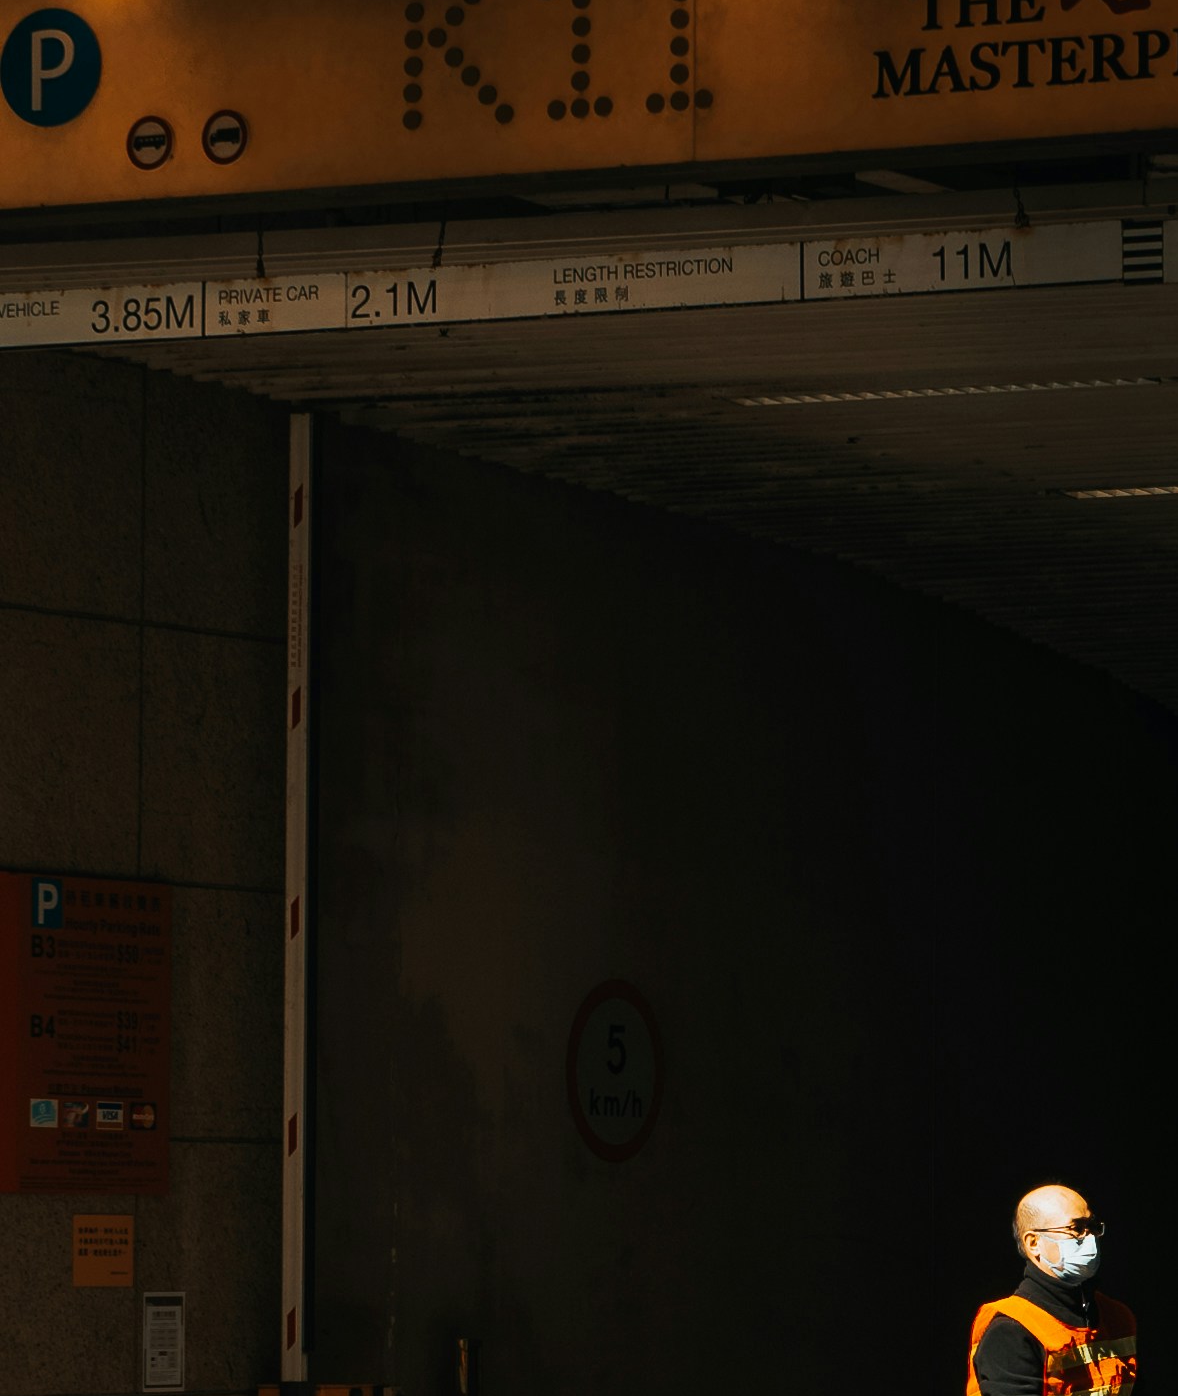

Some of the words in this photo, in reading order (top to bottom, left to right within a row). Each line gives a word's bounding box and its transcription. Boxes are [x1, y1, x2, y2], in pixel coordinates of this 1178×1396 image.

[31, 29, 76, 112] P
[554, 265, 619, 284] LENGTH
[624, 257, 734, 280] RESTRICTION
[818, 248, 880, 267] COACH
[933, 240, 1013, 282] 11M
[819, 268, 897, 290] 旅遊巴士
[219, 288, 282, 305] PRIVATE
[286, 285, 319, 301] CAR
[351, 279, 438, 319] 2.1M
[555, 285, 630, 307] 長度限制
[0, 300, 60, 319] VEHICLE
[92, 294, 195, 334] 3.85M
[218, 308, 271, 327] 私家車
[38, 882, 59, 925] P
[100, 919, 138, 938] Parking
[139, 923, 161, 937] Rate
[31, 935, 56, 958] B3
[31, 1013, 56, 1038] B4
[606, 1024, 627, 1076] 5
[588, 1087, 644, 1119] km/h
